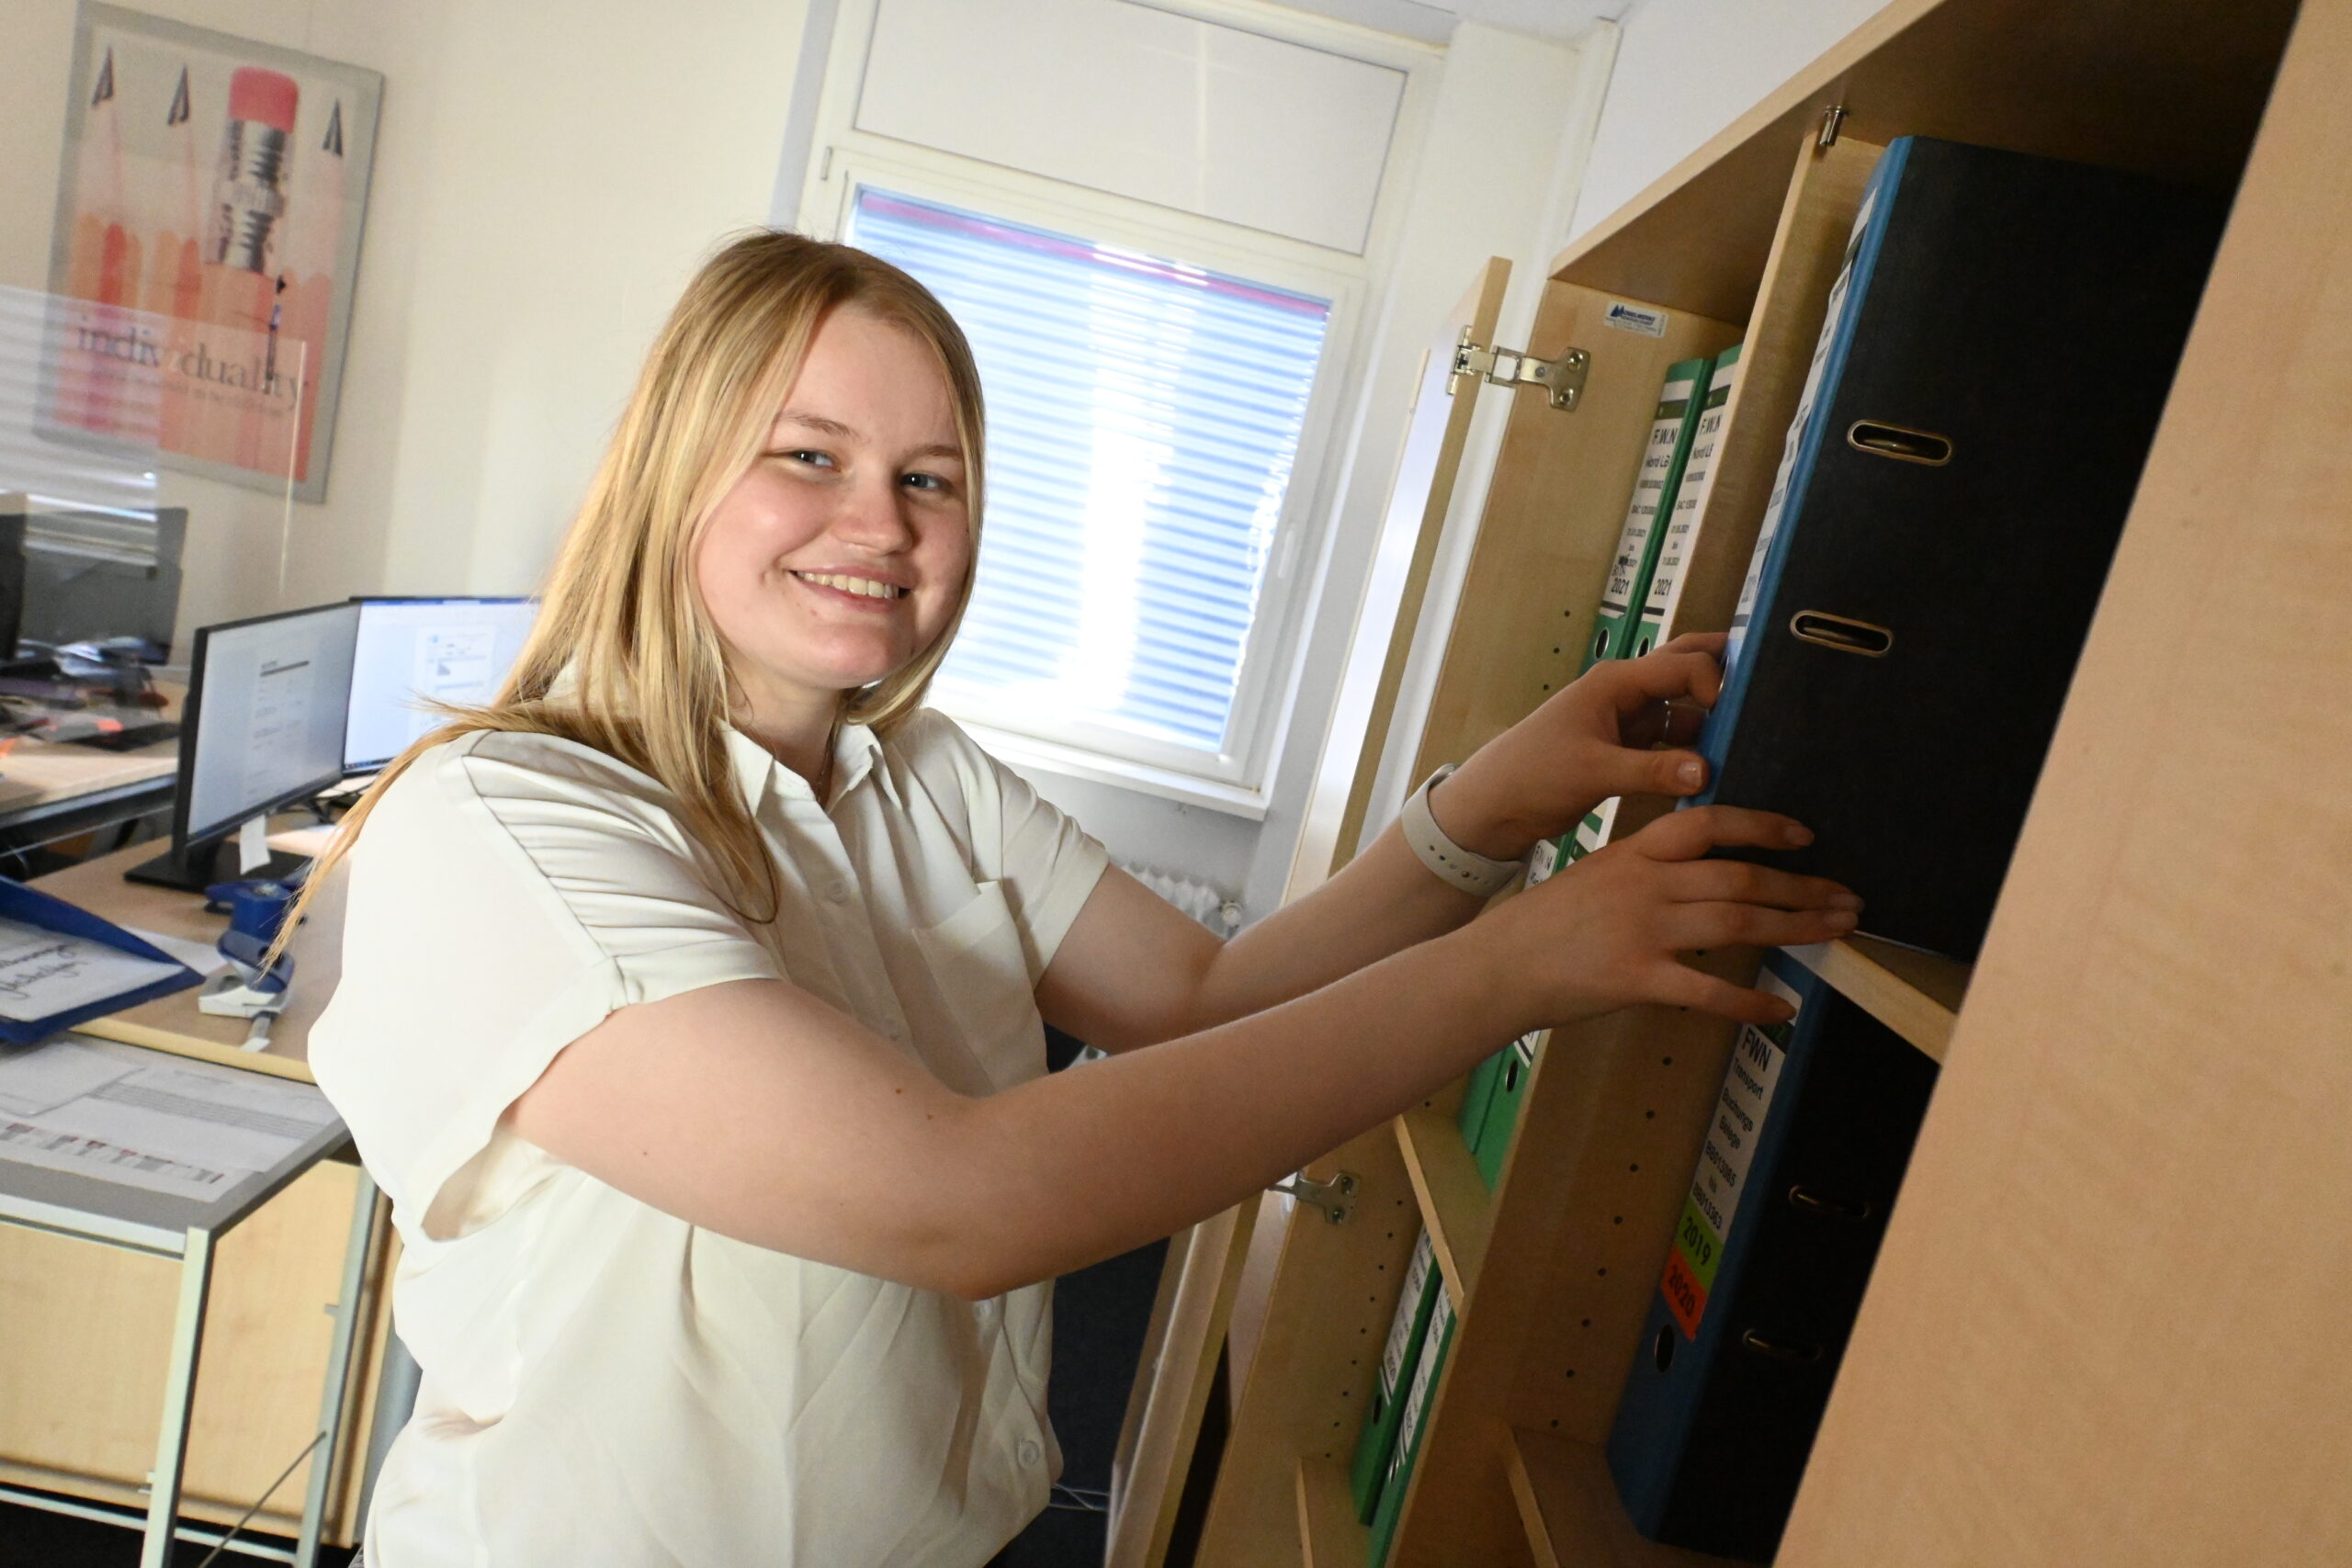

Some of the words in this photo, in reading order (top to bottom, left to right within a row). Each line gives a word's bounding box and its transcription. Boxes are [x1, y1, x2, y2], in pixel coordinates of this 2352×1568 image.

[1611, 577, 1631, 595] 2021
[1654, 578, 1673, 596] 2021
[1742, 1027, 1772, 1072] FWN
[1733, 1057, 1764, 1100] Transport
[1719, 1114, 1741, 1149] Belege
[1722, 1087, 1754, 1133] Buchungs
[1684, 1215, 1712, 1266] 2019
[1668, 1265, 1696, 1317] 2020
